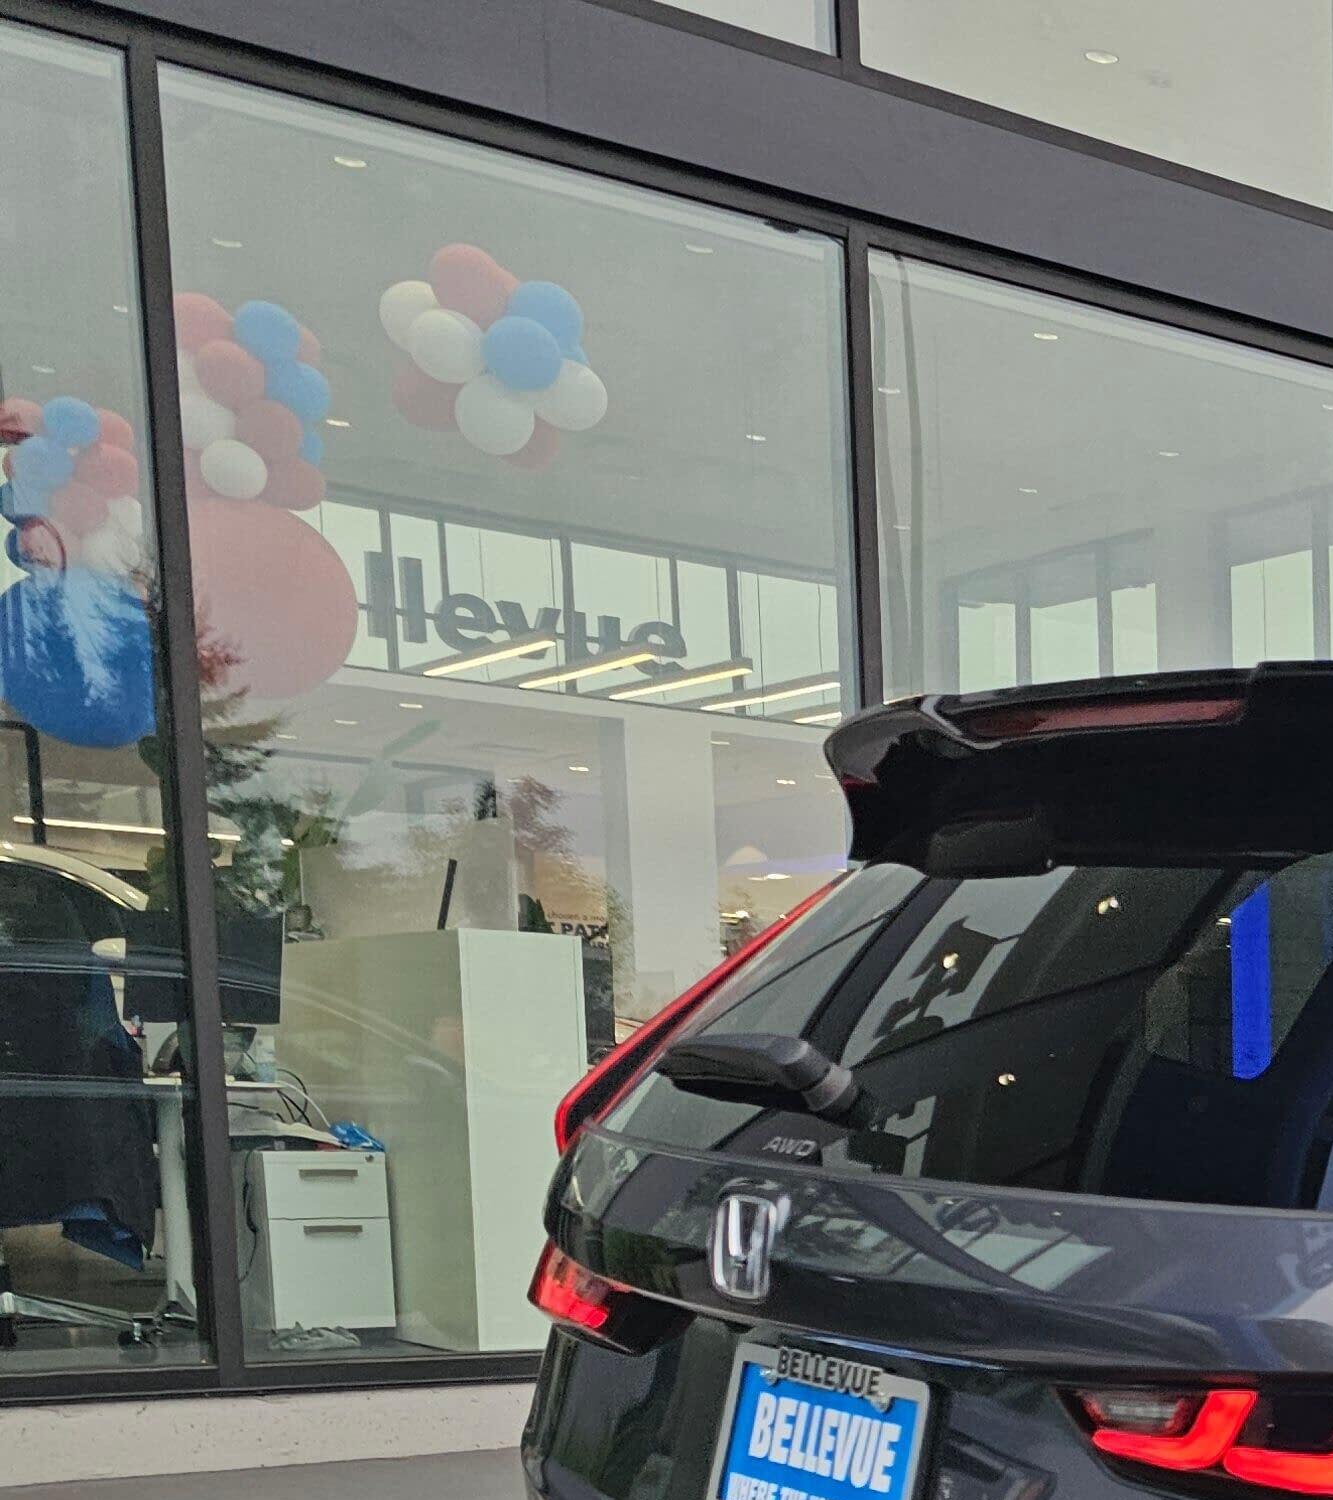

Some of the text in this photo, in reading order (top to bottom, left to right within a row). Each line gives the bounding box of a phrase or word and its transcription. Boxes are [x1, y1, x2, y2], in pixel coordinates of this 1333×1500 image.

[762, 1136, 817, 1157] AWD
[778, 1348, 881, 1396] BELLEVUE
[748, 1392, 901, 1493] BELLEVUE
